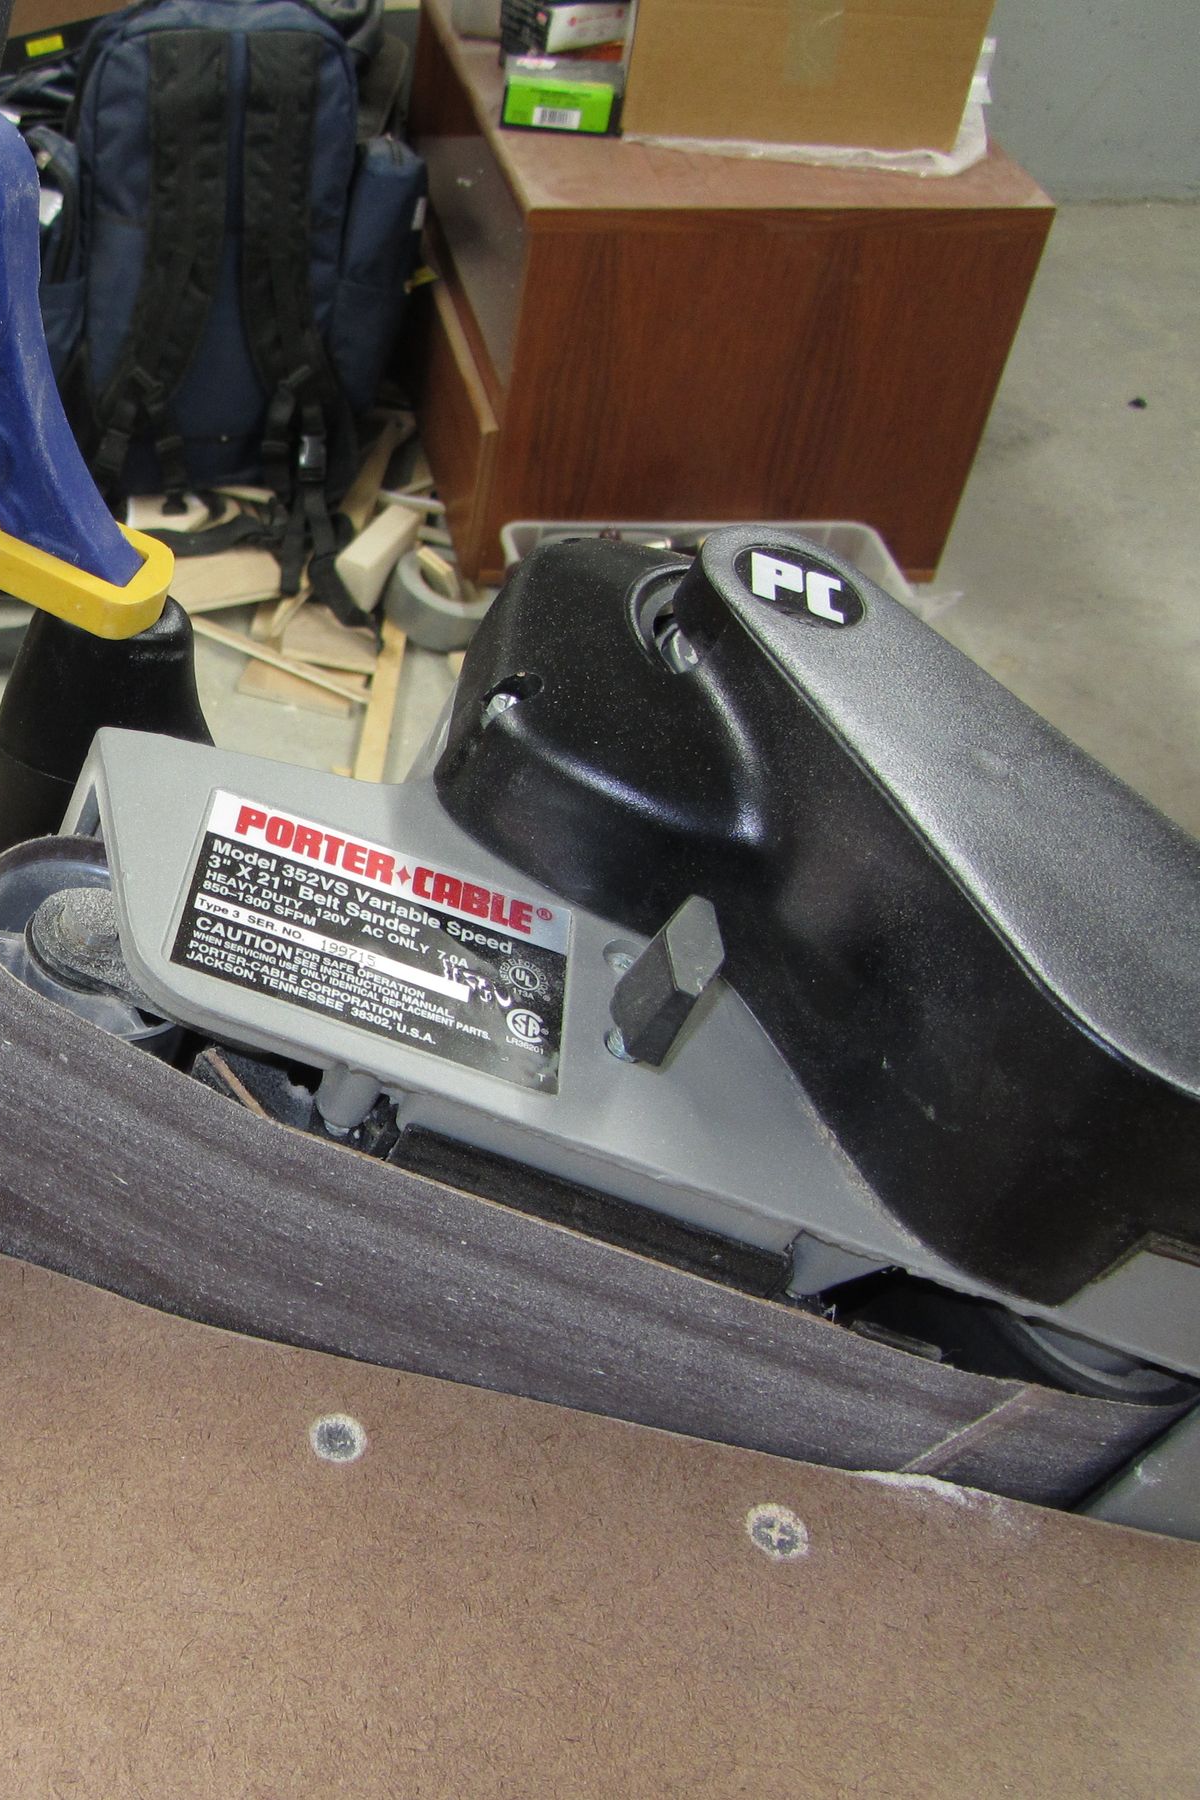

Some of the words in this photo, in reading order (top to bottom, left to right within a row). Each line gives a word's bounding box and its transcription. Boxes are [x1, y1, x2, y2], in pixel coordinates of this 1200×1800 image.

[751, 551, 844, 624] PC
[208, 855, 231, 870] 3"
[236, 864, 253, 880] X
[257, 871, 292, 890] 21"
[298, 885, 340, 911] Belt
[345, 901, 420, 937] Sander
[212, 839, 277, 872] Model
[281, 864, 349, 897] 352VS
[356, 887, 441, 929] Variable
[446, 920, 513, 955] Speed
[234, 805, 395, 886] PORTER
[412, 866, 533, 935] CABLE
[196, 917, 293, 959] CAUTION
[199, 898, 229, 915] Type
[232, 910, 240, 919] 3
[247, 915, 278, 932] SER.
[282, 926, 304, 941] NO.
[320, 939, 377, 967] 199715
[205, 870, 258, 894] HEAVY
[261, 889, 303, 910] DUTY
[315, 907, 350, 926] 120V
[361, 924, 385, 939] AC
[387, 933, 430, 954] ONLY
[437, 950, 469, 969] 7.0A
[273, 904, 317, 926] SFPM
[186, 951, 257, 983] JACKSON,
[261, 975, 345, 1011] TENNESSEE
[350, 1006, 392, 1030] 38302,
[396, 1022, 436, 1045] U.S.A.
[189, 940, 298, 984] PORTER-CABLE
[301, 978, 403, 1022] CORPORATION
[192, 930, 222, 947] WHEN
[224, 940, 276, 964] SERVICING
[278, 959, 298, 972] USE
[300, 967, 328, 982] ONLY
[329, 976, 380, 1001] IDENTICAL
[382, 995, 456, 1027] REPLACEMENT
[456, 1021, 491, 1040] PARTS.
[293, 956, 318, 970] SEE
[320, 964, 399, 999] INSTRUCTION
[295, 947, 321, 963] FOR
[322, 957, 355, 974] SAFE
[357, 968, 425, 1000] OPERATION
[515, 968, 533, 988] UL
